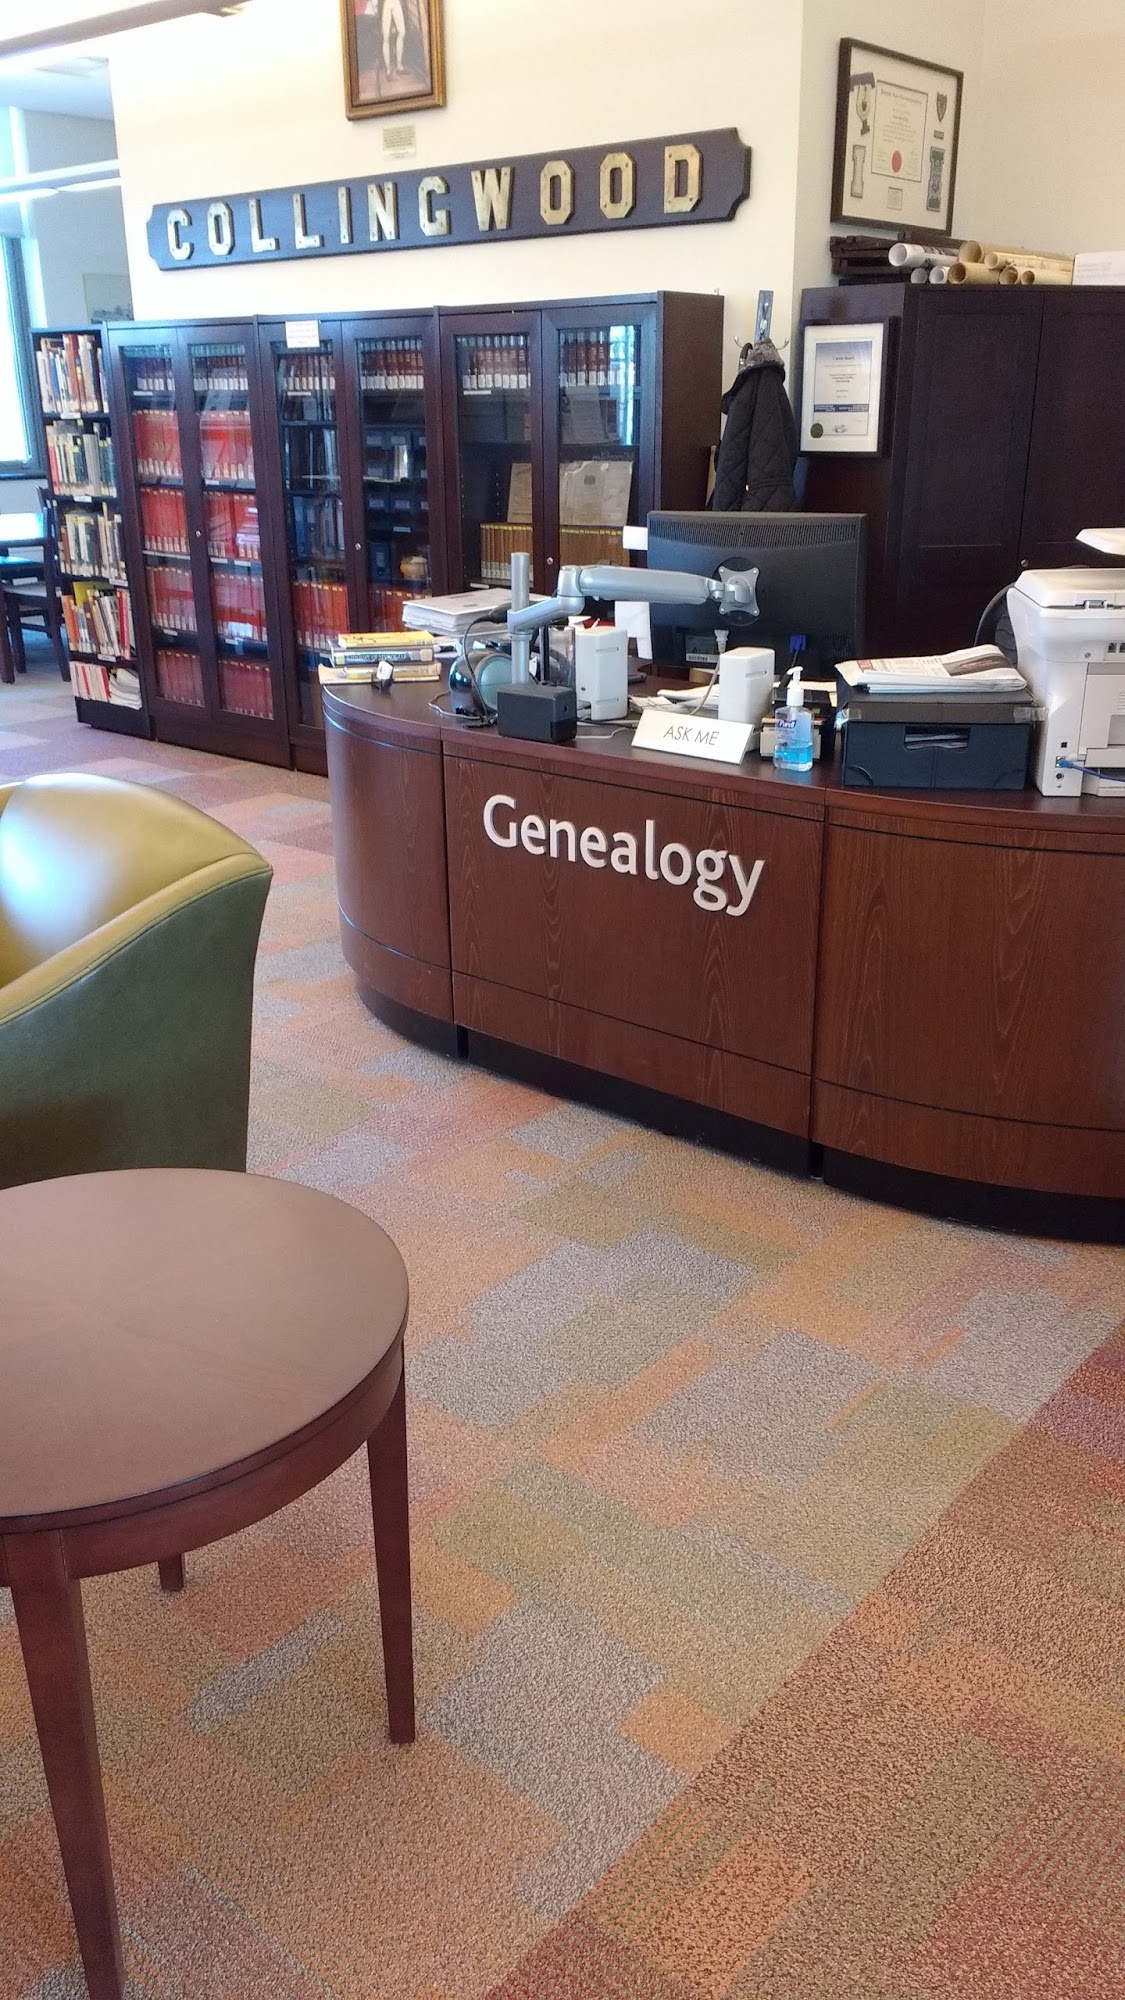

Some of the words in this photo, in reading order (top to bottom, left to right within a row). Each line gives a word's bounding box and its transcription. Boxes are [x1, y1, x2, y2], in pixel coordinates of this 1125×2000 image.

[167, 143, 704, 261] COLLINGWOOD
[664, 725, 693, 741] ASK
[694, 730, 719, 746] ME
[483, 794, 766, 917] Genealogy
